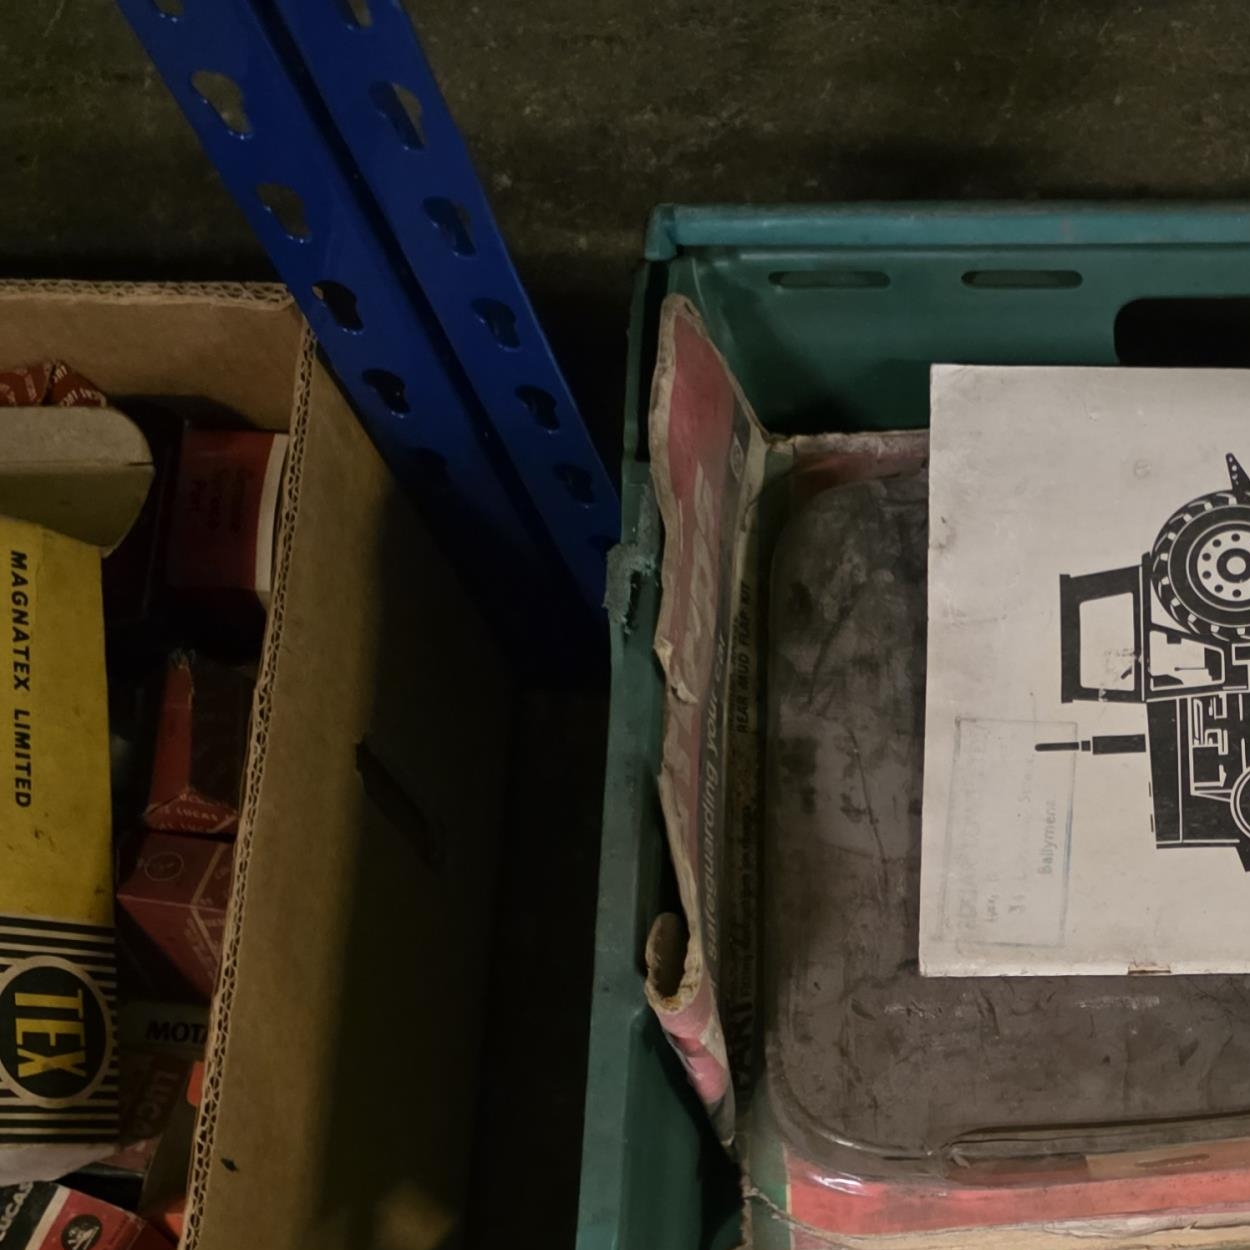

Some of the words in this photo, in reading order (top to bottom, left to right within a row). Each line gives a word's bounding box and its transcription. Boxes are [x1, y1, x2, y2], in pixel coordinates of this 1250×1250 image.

[10, 550, 30, 692] MAGNATEX
[739, 609, 751, 647] FLAP
[740, 580, 751, 607] KIT
[738, 653, 750, 691] MUD
[705, 686, 719, 759] your
[737, 695, 750, 734] REAR
[14, 708, 32, 808] LIMITED
[700, 760, 719, 960] safeguarding
[14, 988, 88, 1079] TEX
